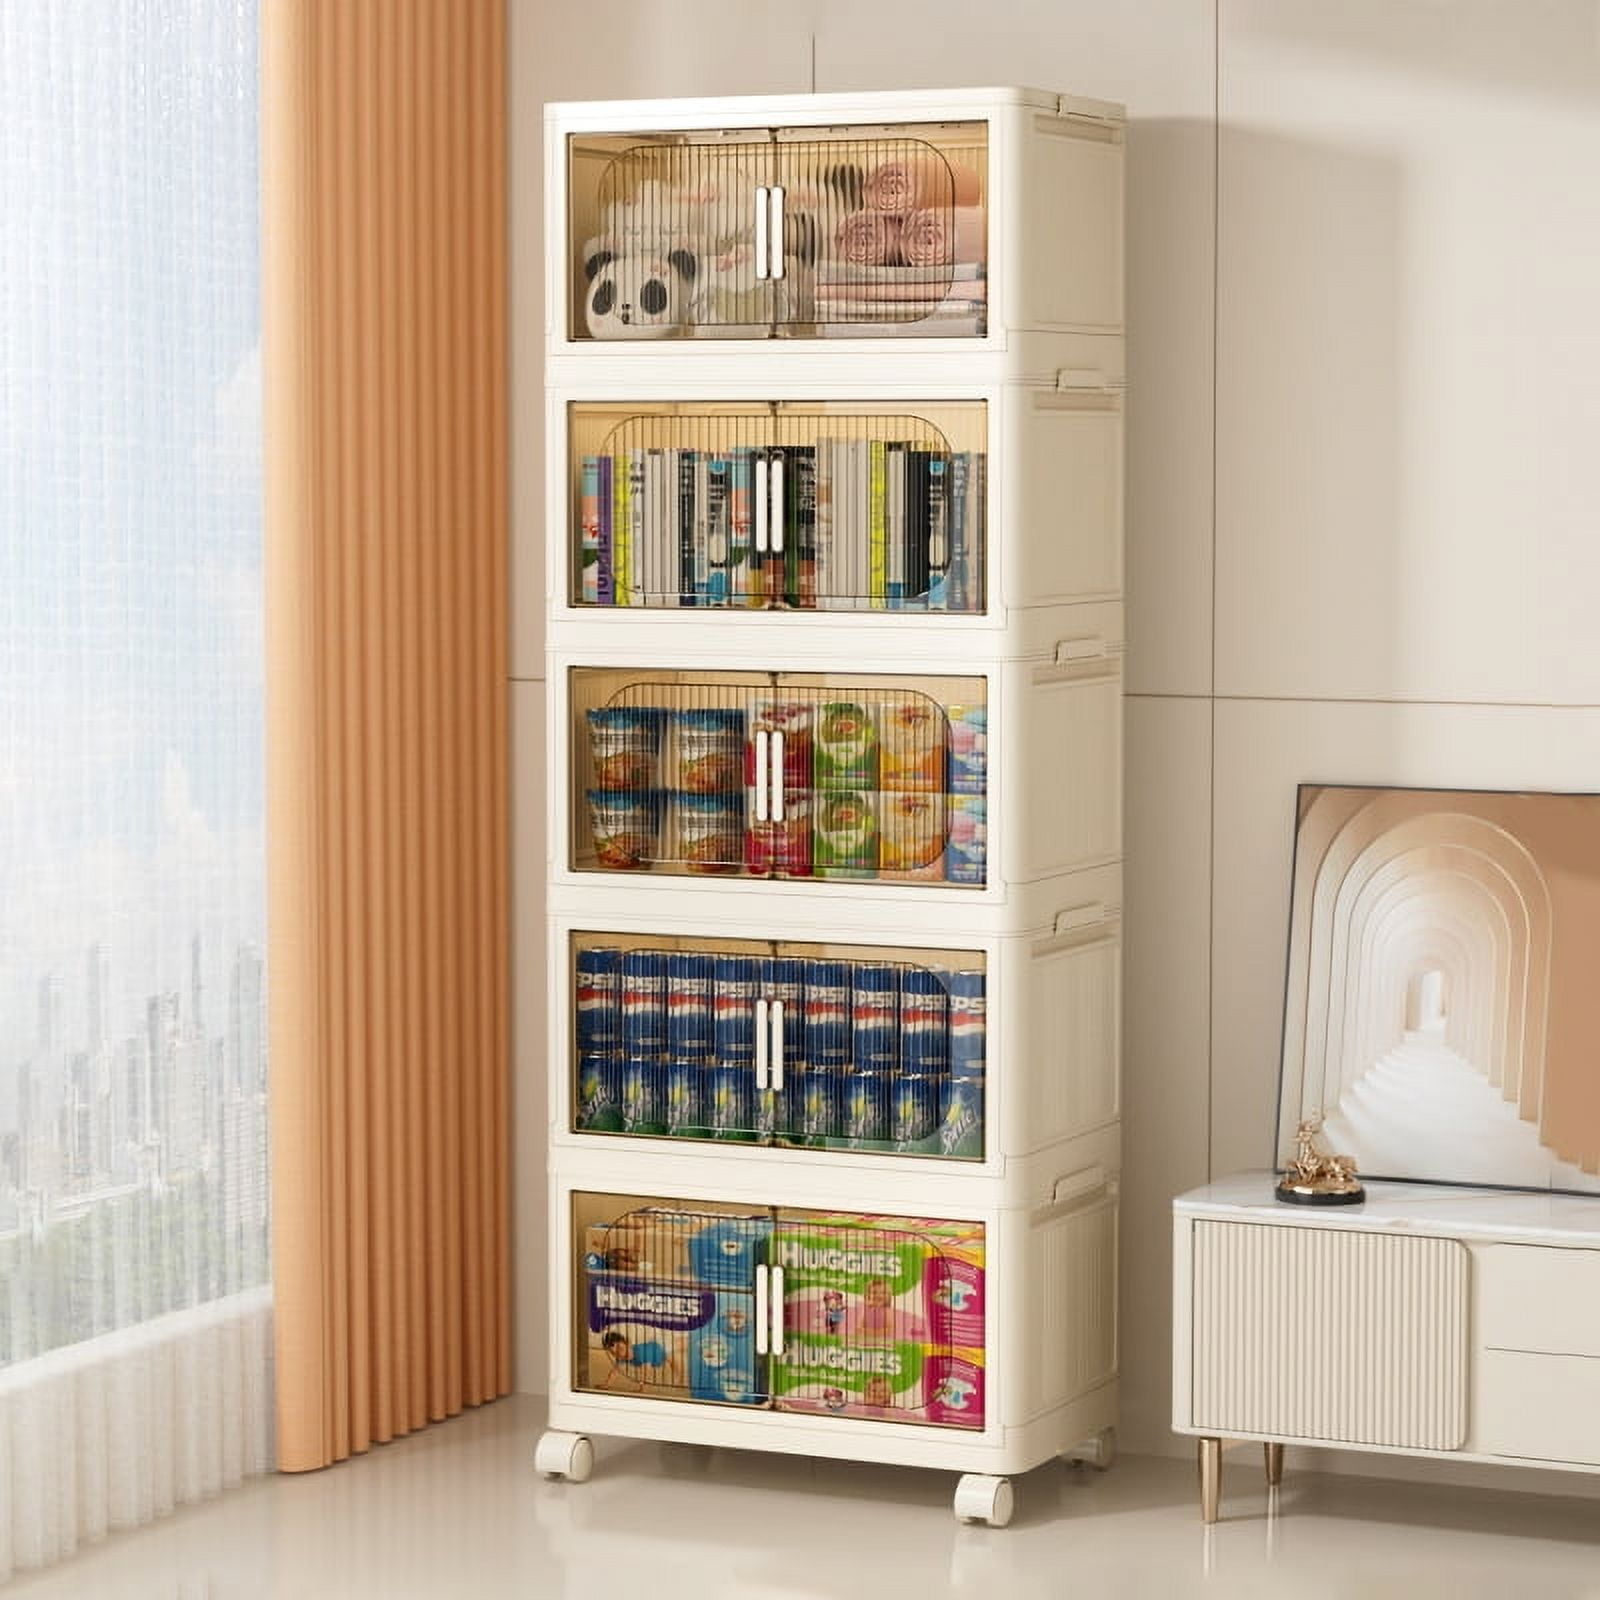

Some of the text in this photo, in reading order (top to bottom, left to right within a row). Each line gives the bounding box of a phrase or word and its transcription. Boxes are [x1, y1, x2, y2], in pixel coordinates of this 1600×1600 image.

[780, 1241, 901, 1278] HUGGIES
[596, 1284, 700, 1317] HUGGIES
[780, 1338, 901, 1375] HUGGIES
